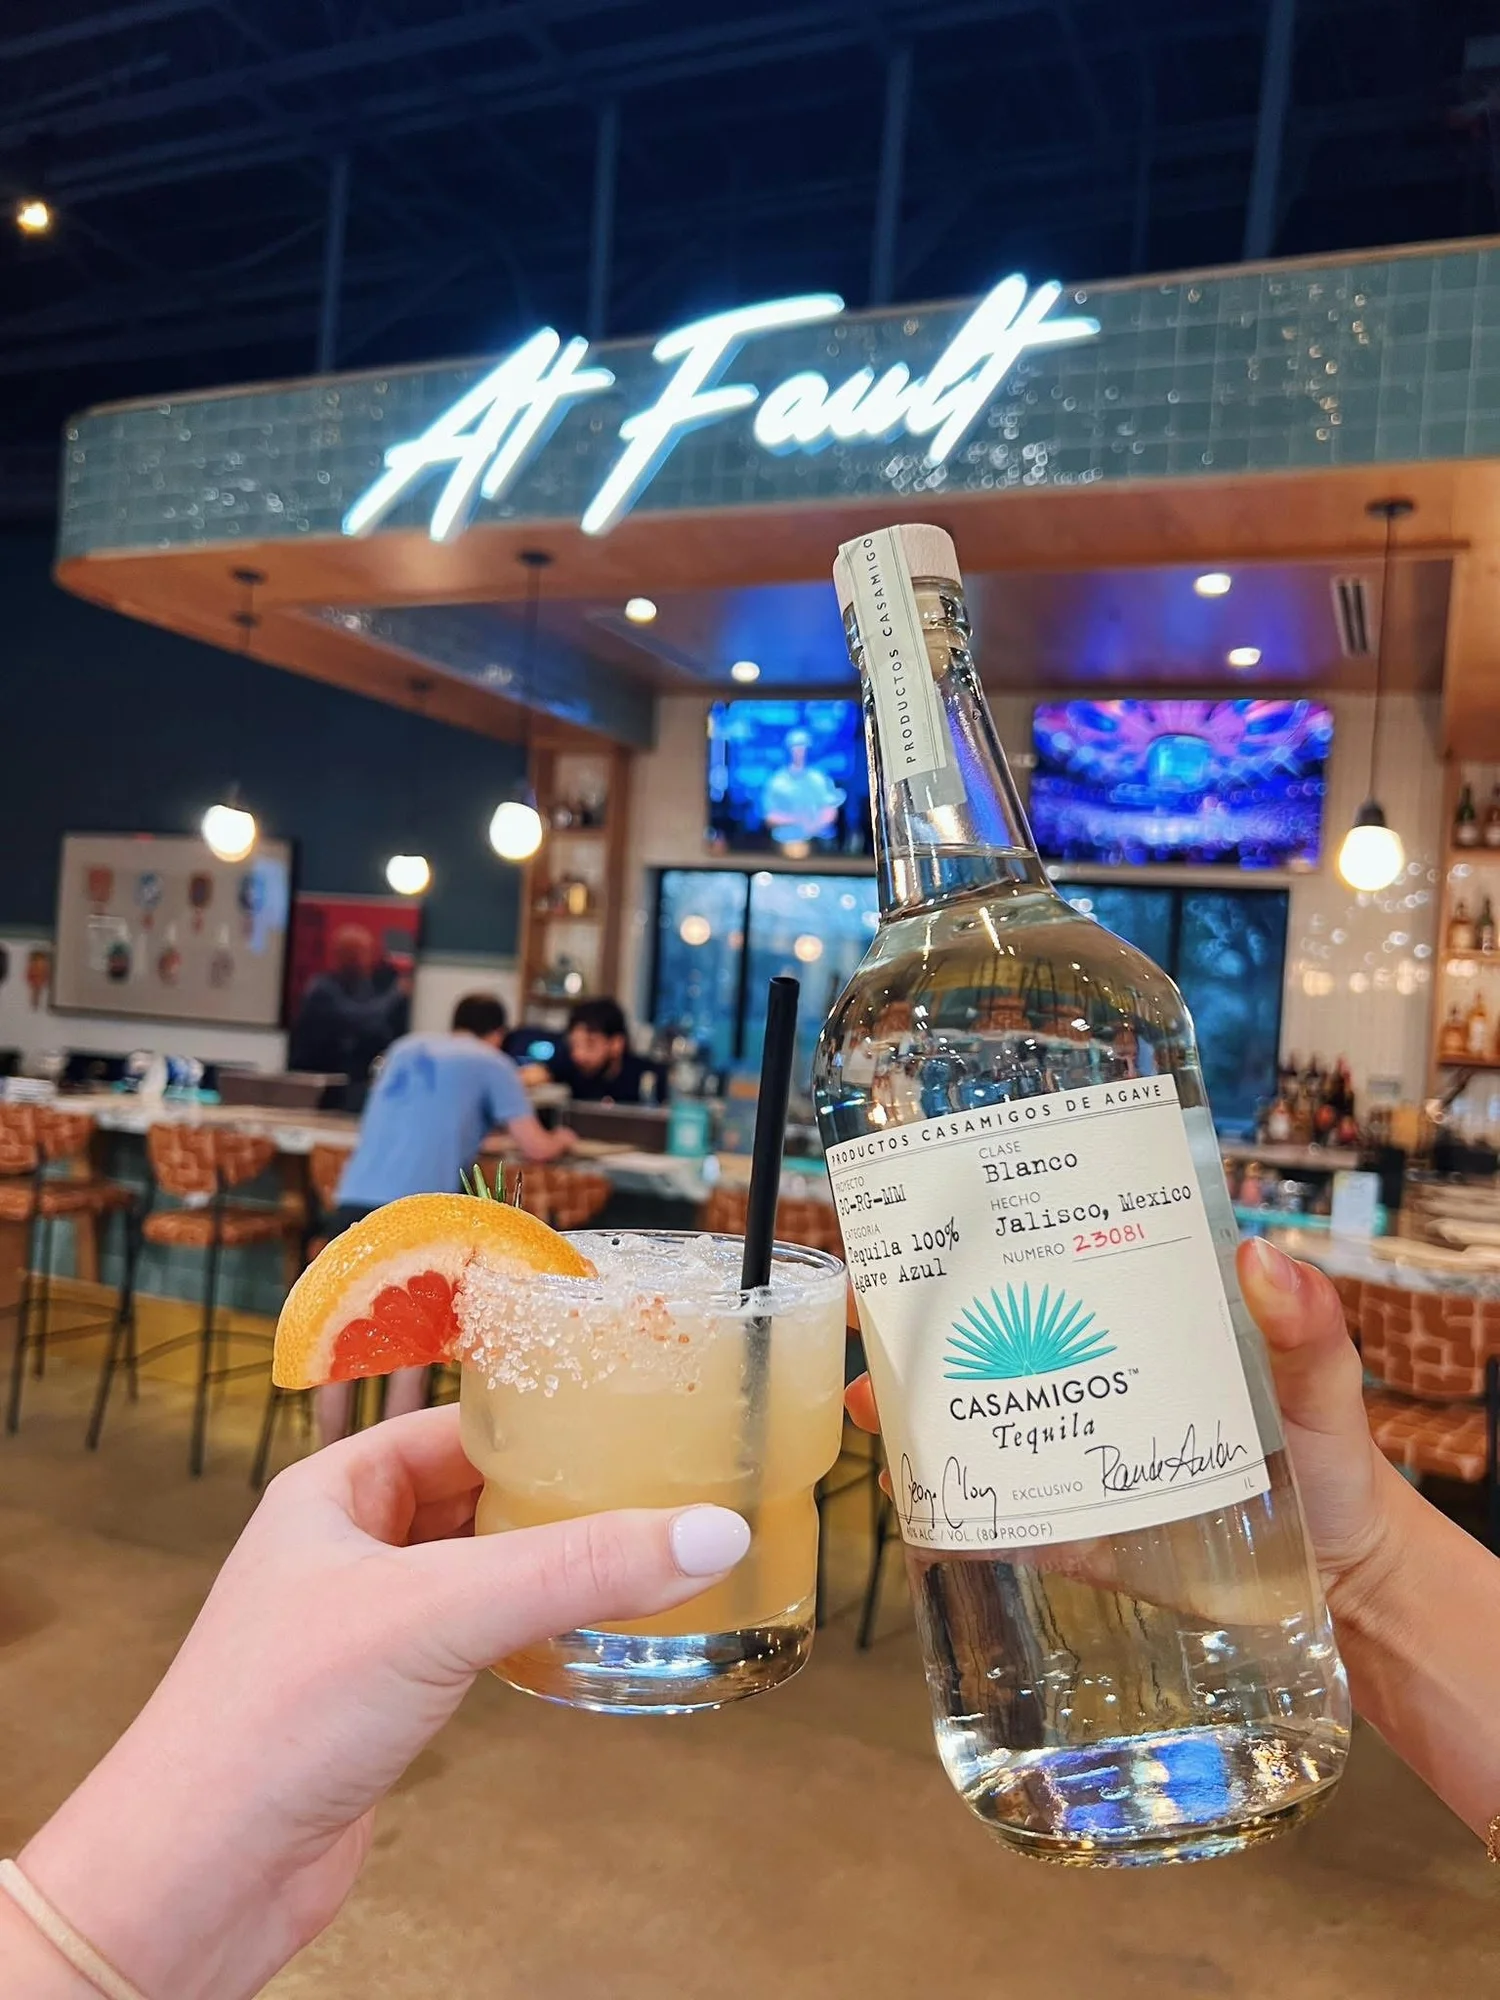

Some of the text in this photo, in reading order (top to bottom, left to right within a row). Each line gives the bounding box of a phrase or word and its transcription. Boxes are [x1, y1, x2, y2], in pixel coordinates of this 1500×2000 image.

[342, 273, 1101, 541] At Fault
[889, 648, 917, 764] PRODUCTOS
[831, 1084, 1162, 1167] PRODUCTOS CASAMIGOS DE AGAVE
[979, 1141, 1022, 1160] CLASE
[982, 1152, 1078, 1184] Blanco
[990, 1191, 1041, 1211] HECHO
[995, 1185, 1192, 1237] Jalisco, Mexico
[848, 1216, 960, 1267] Tequila 100%
[1002, 1223, 1145, 1265] NUMERO 23081
[854, 1257, 948, 1293] Agave Azul
[949, 1370, 1129, 1421] CASAMIGOS
[992, 1411, 1096, 1454] Tequila
[1012, 1480, 1084, 1501] EXCLUSIVO
[1000, 1522, 1054, 1540] PROOF)
